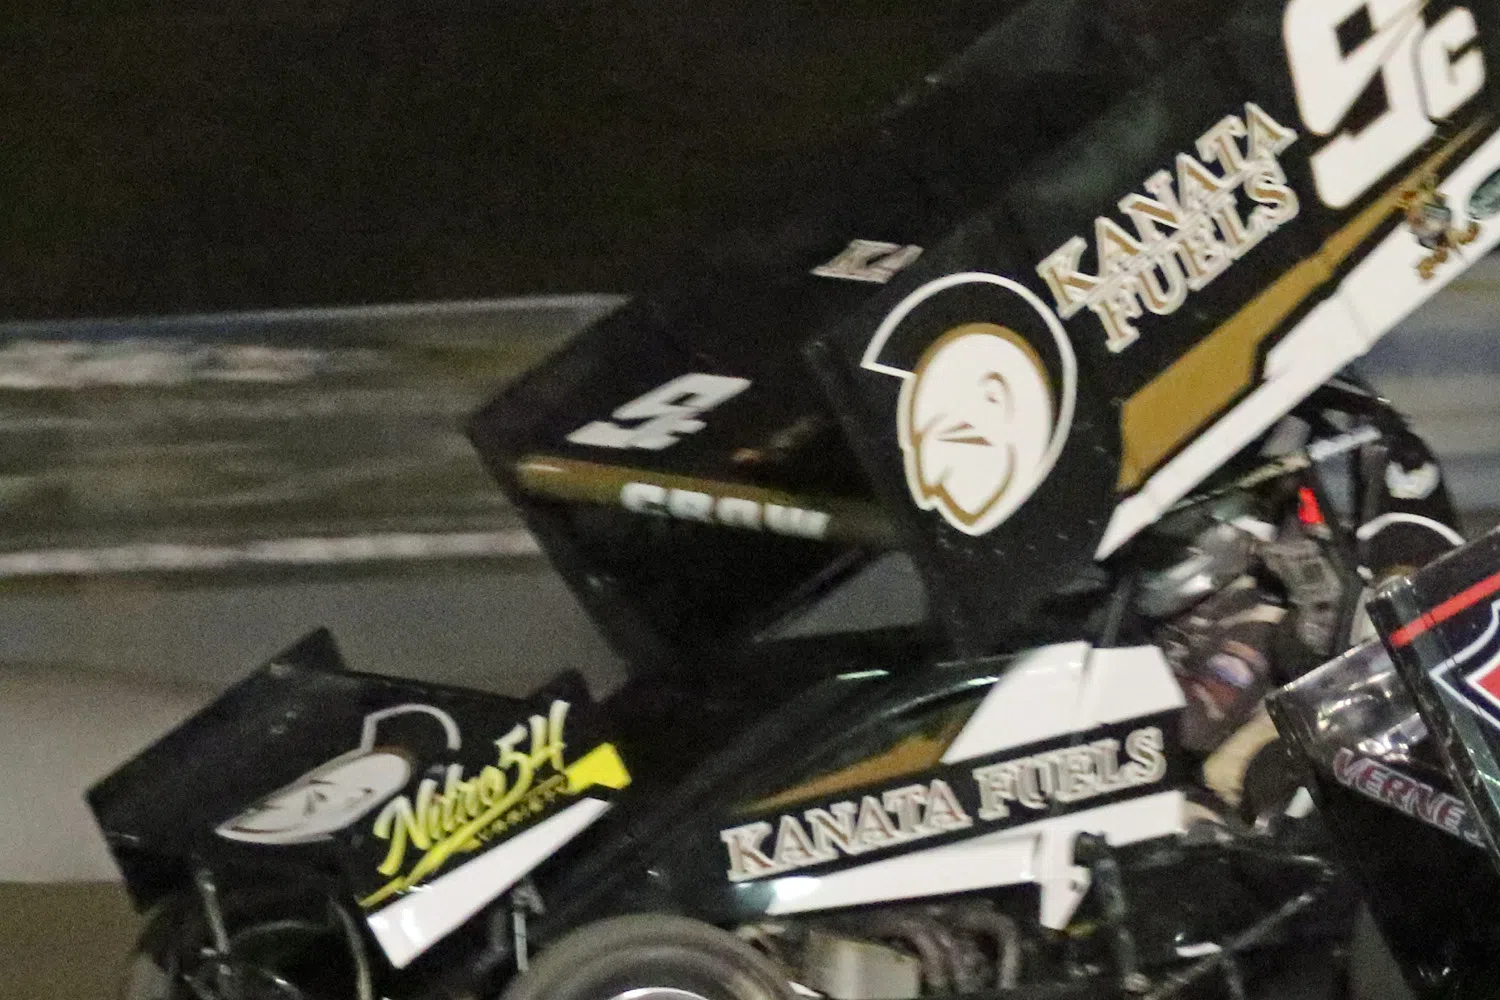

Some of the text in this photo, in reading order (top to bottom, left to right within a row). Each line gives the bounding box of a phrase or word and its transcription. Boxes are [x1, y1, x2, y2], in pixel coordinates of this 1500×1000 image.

[1036, 102, 1299, 320] KANATA
[1092, 156, 1301, 354] FUELS
[721, 726, 1167, 882] KANATA FUELS
